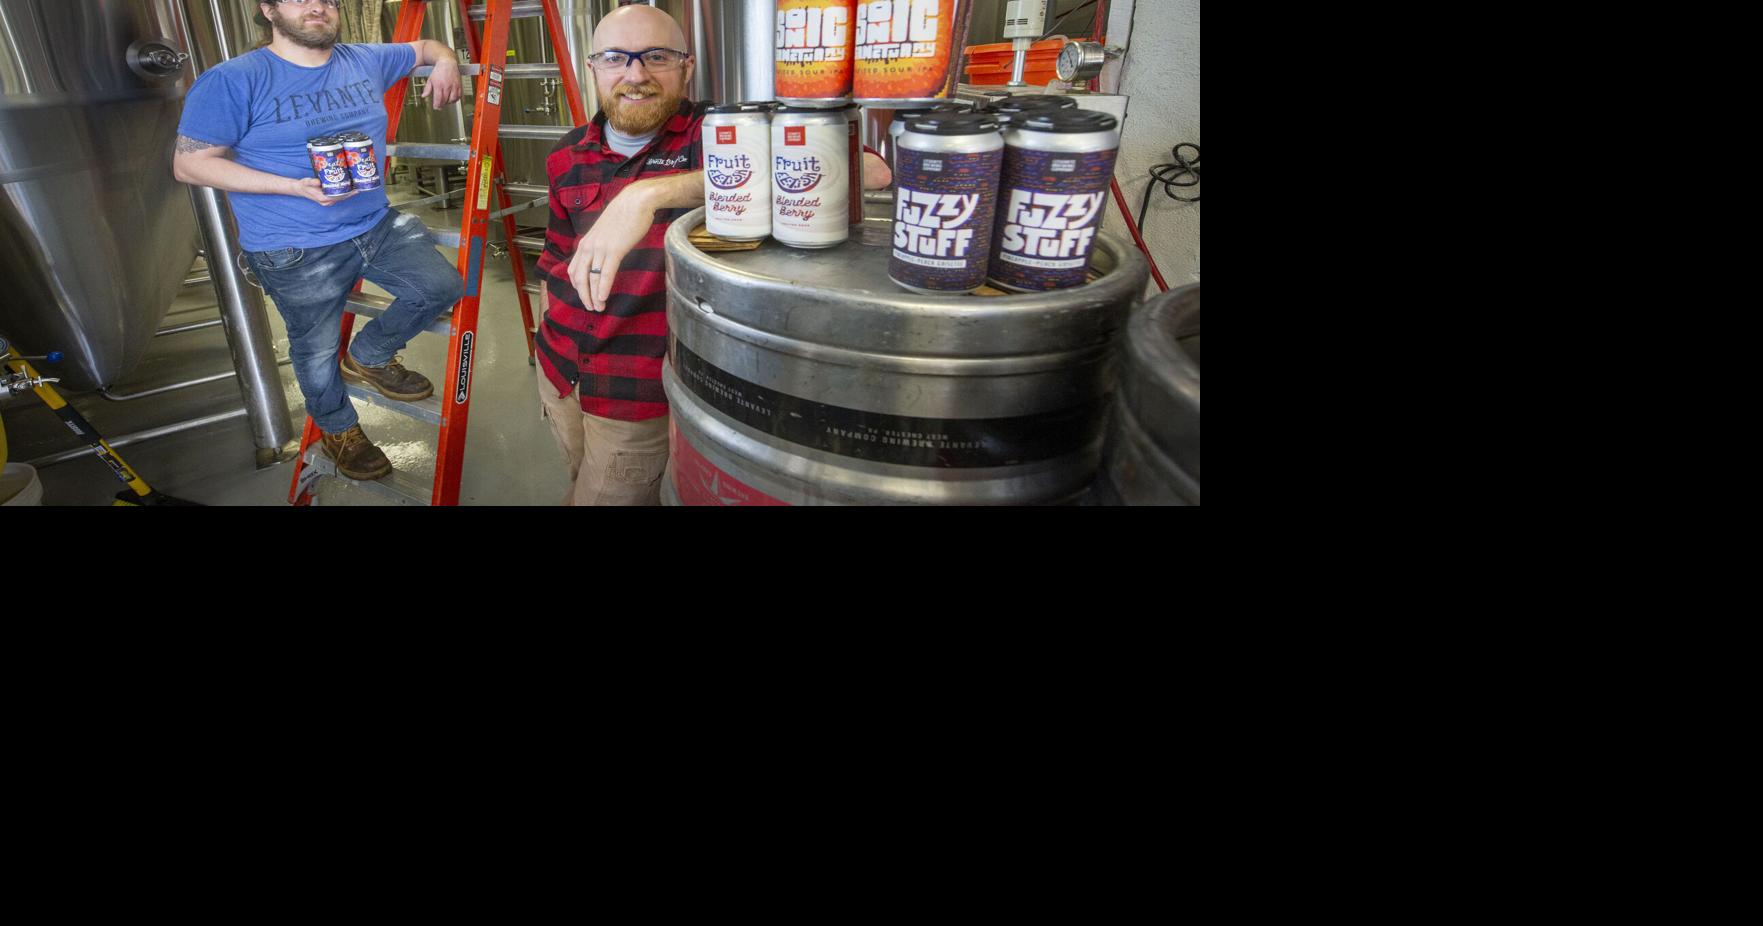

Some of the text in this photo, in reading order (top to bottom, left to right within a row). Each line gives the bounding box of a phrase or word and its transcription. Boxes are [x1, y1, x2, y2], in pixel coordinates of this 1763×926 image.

[273, 79, 380, 124] LEVANTE
[708, 154, 751, 169] Fruit
[775, 156, 821, 171] Fruit
[709, 192, 752, 202] Blended
[776, 195, 821, 208] Blended
[713, 202, 747, 217] Berry
[780, 207, 815, 221] Berry
[460, 333, 471, 391] LOUISVILLE
[826, 427, 877, 442] COMPANY
